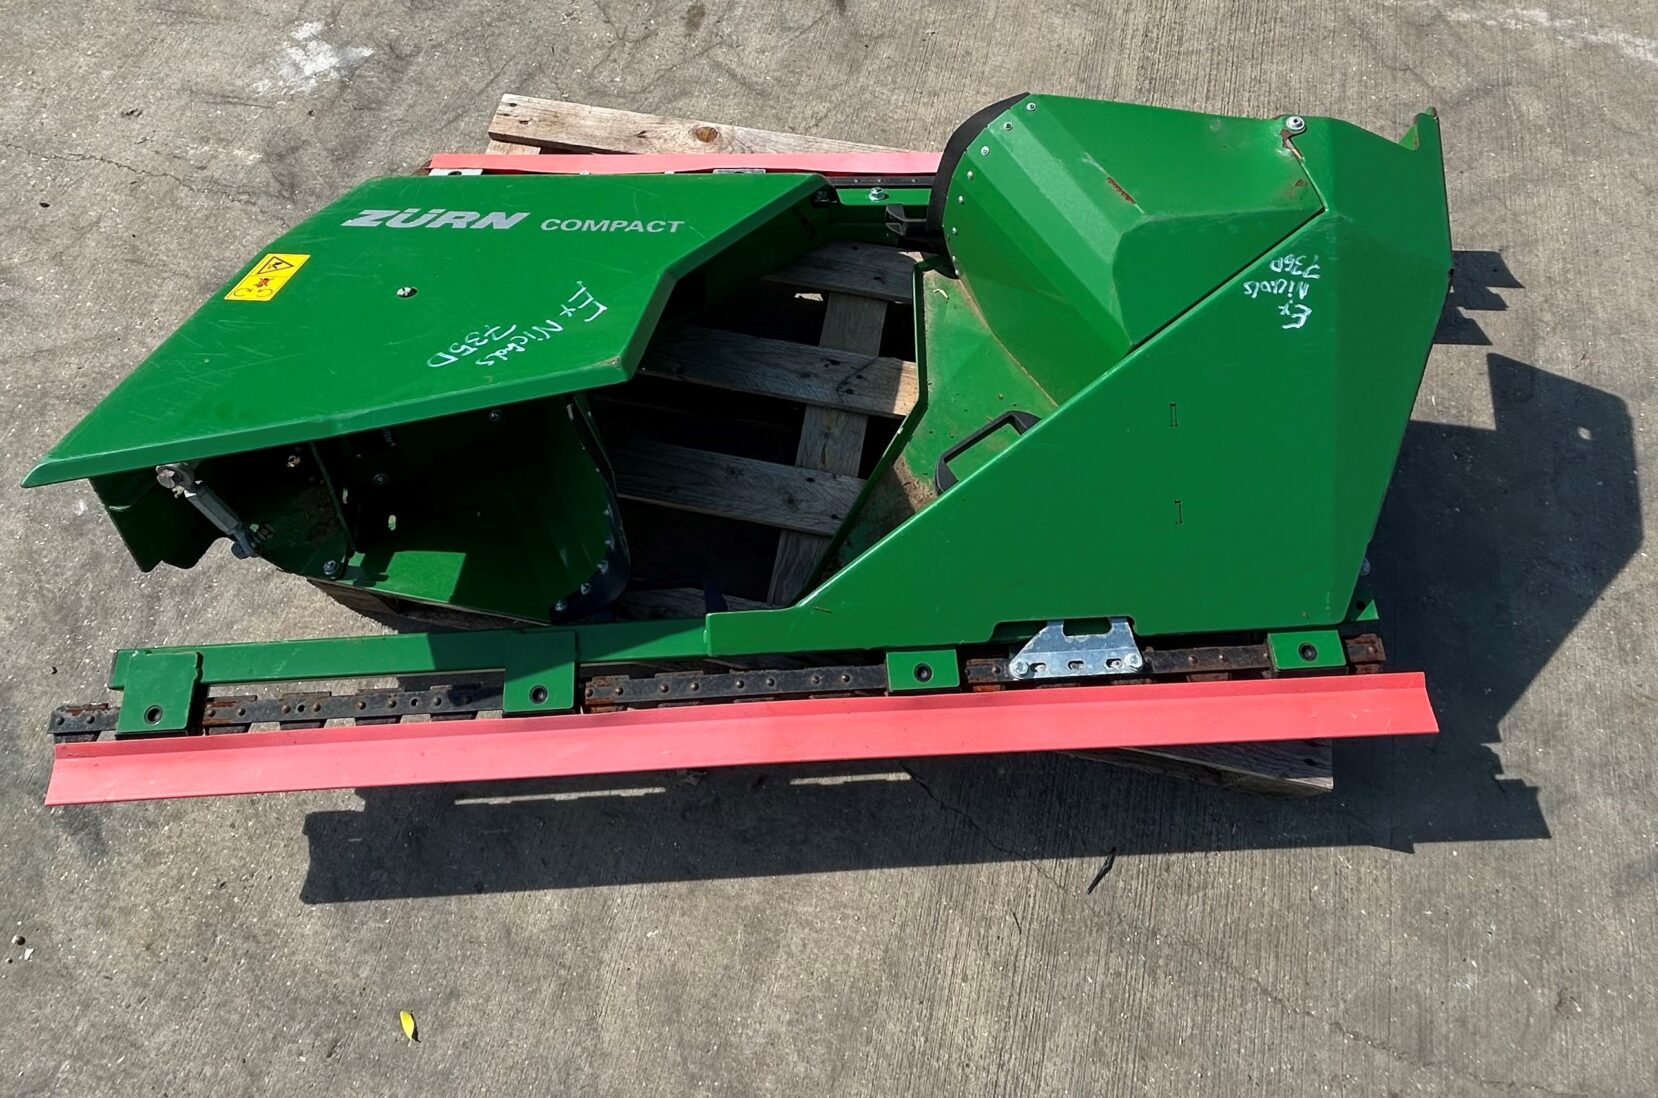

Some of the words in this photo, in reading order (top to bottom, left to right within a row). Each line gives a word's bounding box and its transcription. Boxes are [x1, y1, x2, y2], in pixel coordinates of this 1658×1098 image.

[340, 208, 530, 231] ZÜRN
[540, 218, 686, 233] COMPACT
[557, 280, 608, 323] Ex
